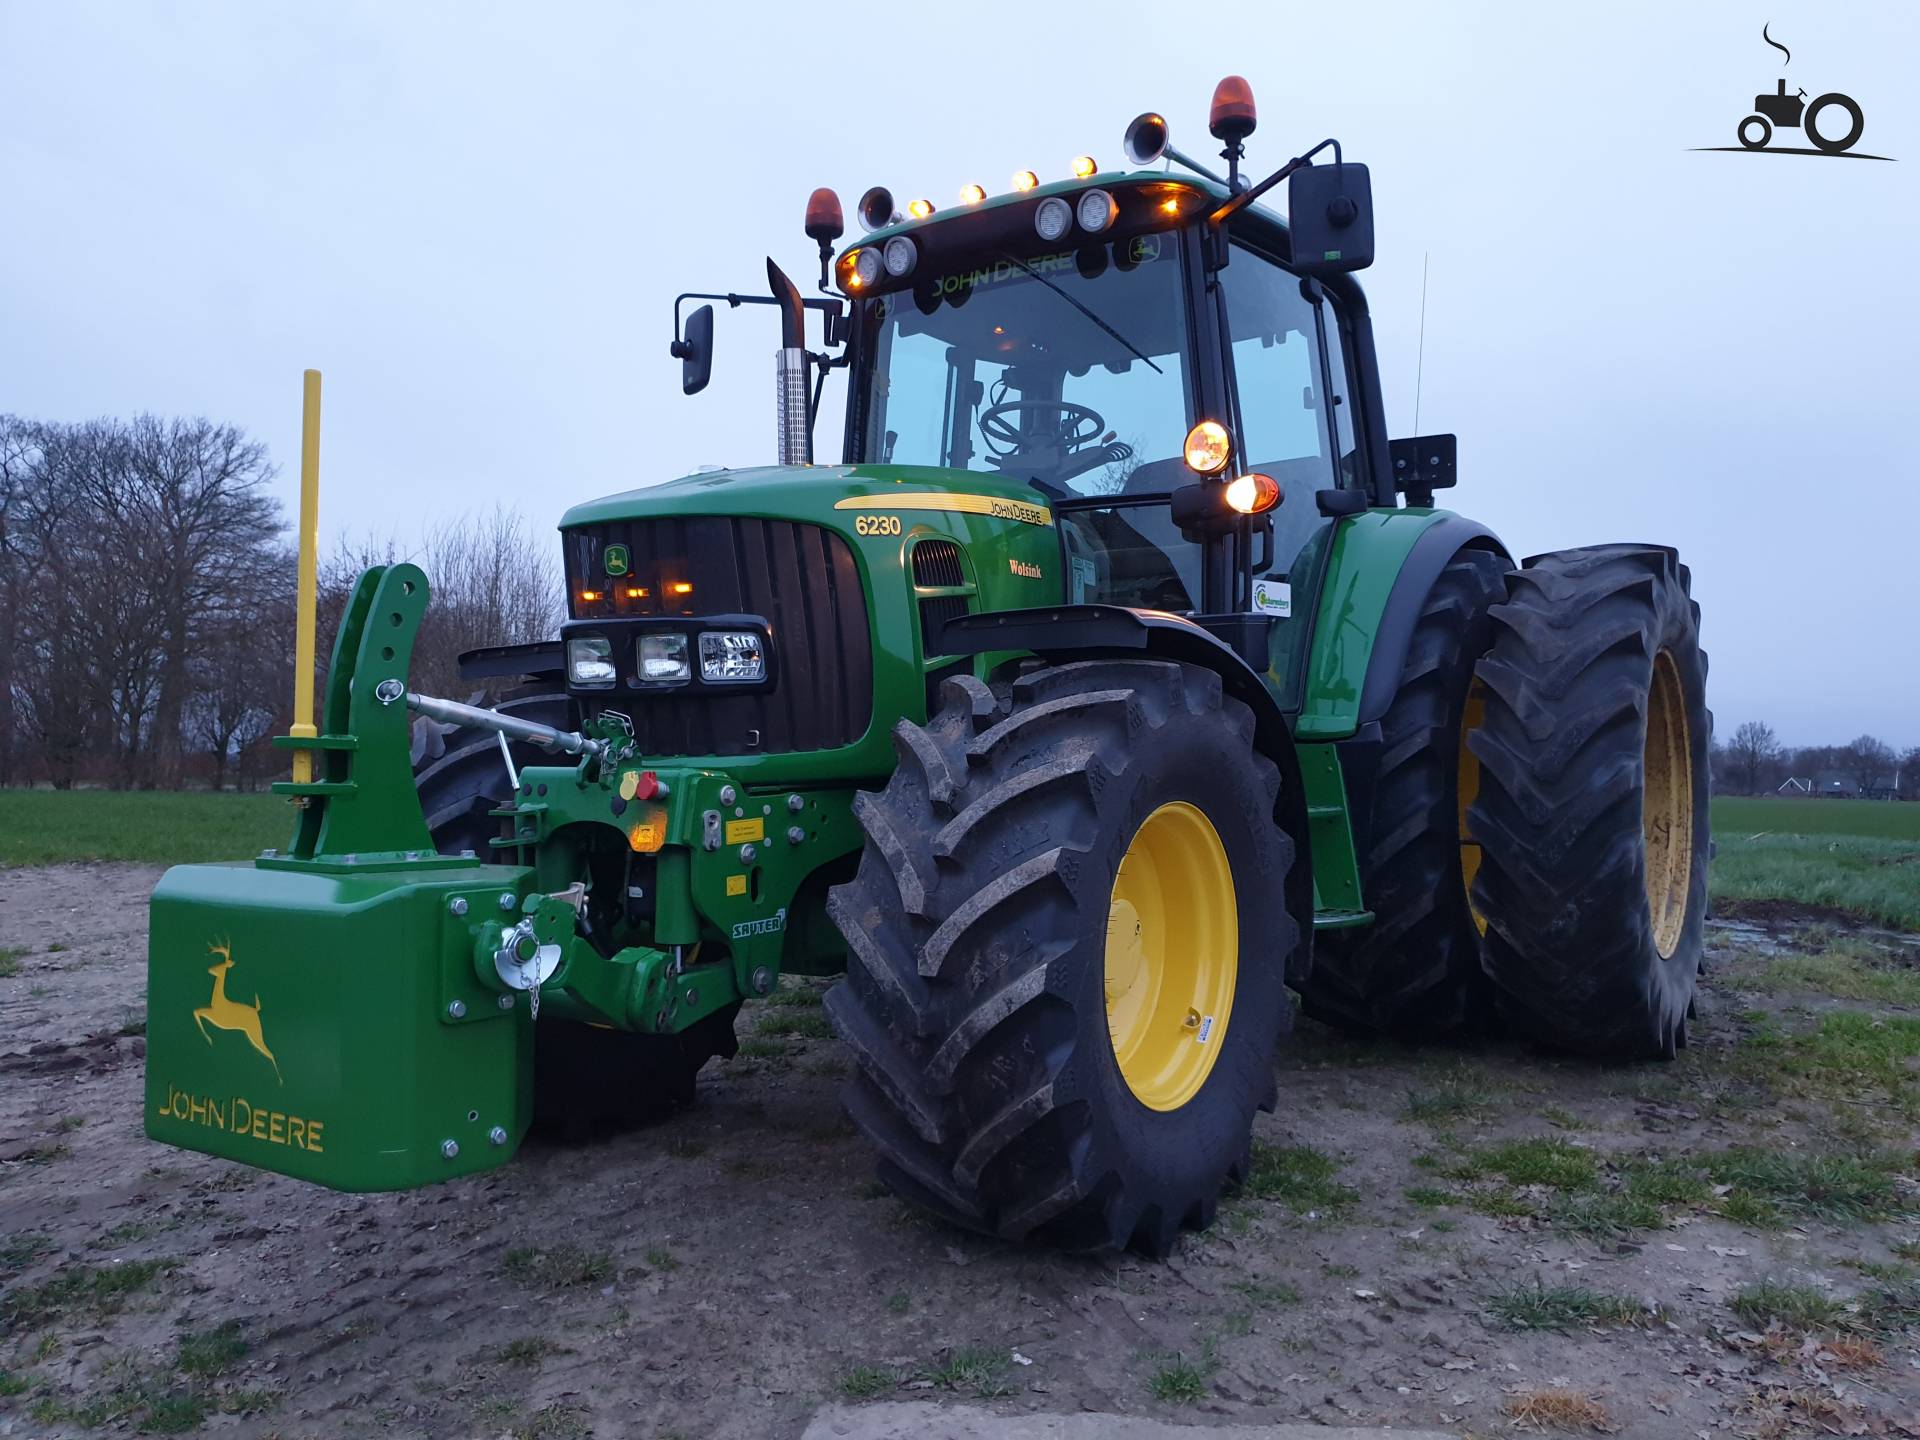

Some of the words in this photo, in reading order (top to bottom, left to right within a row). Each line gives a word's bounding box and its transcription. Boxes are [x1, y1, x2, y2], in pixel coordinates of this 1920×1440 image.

[932, 265, 990, 297] JOHN
[993, 250, 1074, 283] DEERE
[991, 501, 1013, 516] JOHN
[1014, 504, 1042, 523] DEERE
[855, 515, 902, 536] 6230
[1009, 559, 1042, 579] Wolsink
[733, 917, 780, 938] SAUTER
[159, 1081, 225, 1130] JOHN
[230, 1096, 324, 1152] DEERE
